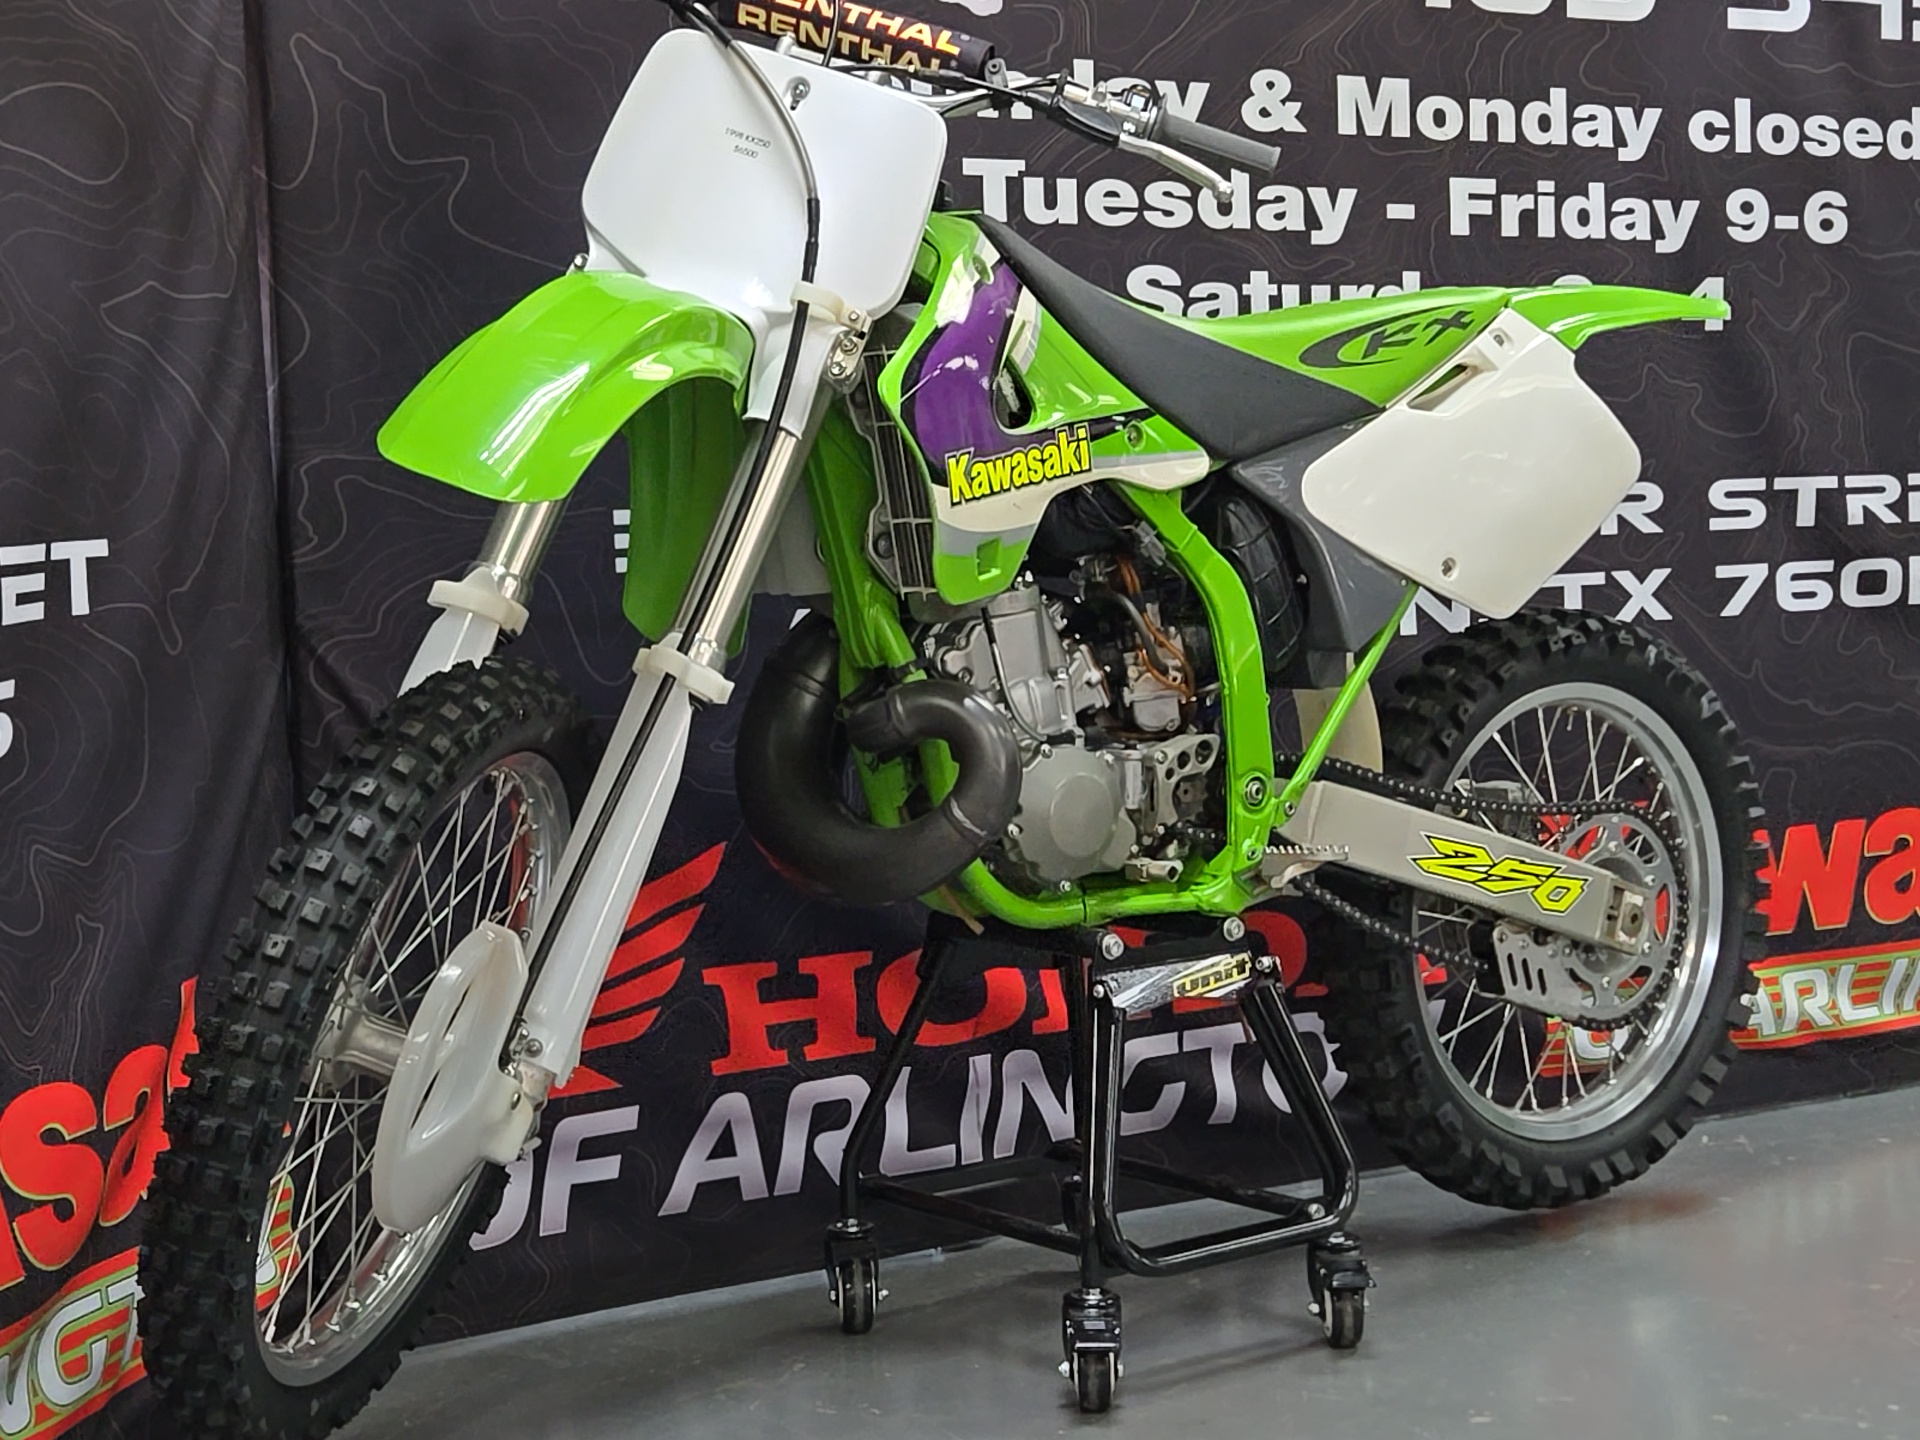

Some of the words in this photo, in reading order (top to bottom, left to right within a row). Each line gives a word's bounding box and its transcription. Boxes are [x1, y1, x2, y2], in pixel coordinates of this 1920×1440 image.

[1241, 68, 1307, 133] &
[1338, 75, 1662, 162] Monday
[962, 157, 1358, 245] Tuesday
[1449, 177, 1700, 253] Friday
[1726, 188, 1848, 244] 9-6
[945, 426, 1093, 506] Kawasaki
[1708, 473, 1920, 532] STR
[1406, 831, 1592, 916] 250
